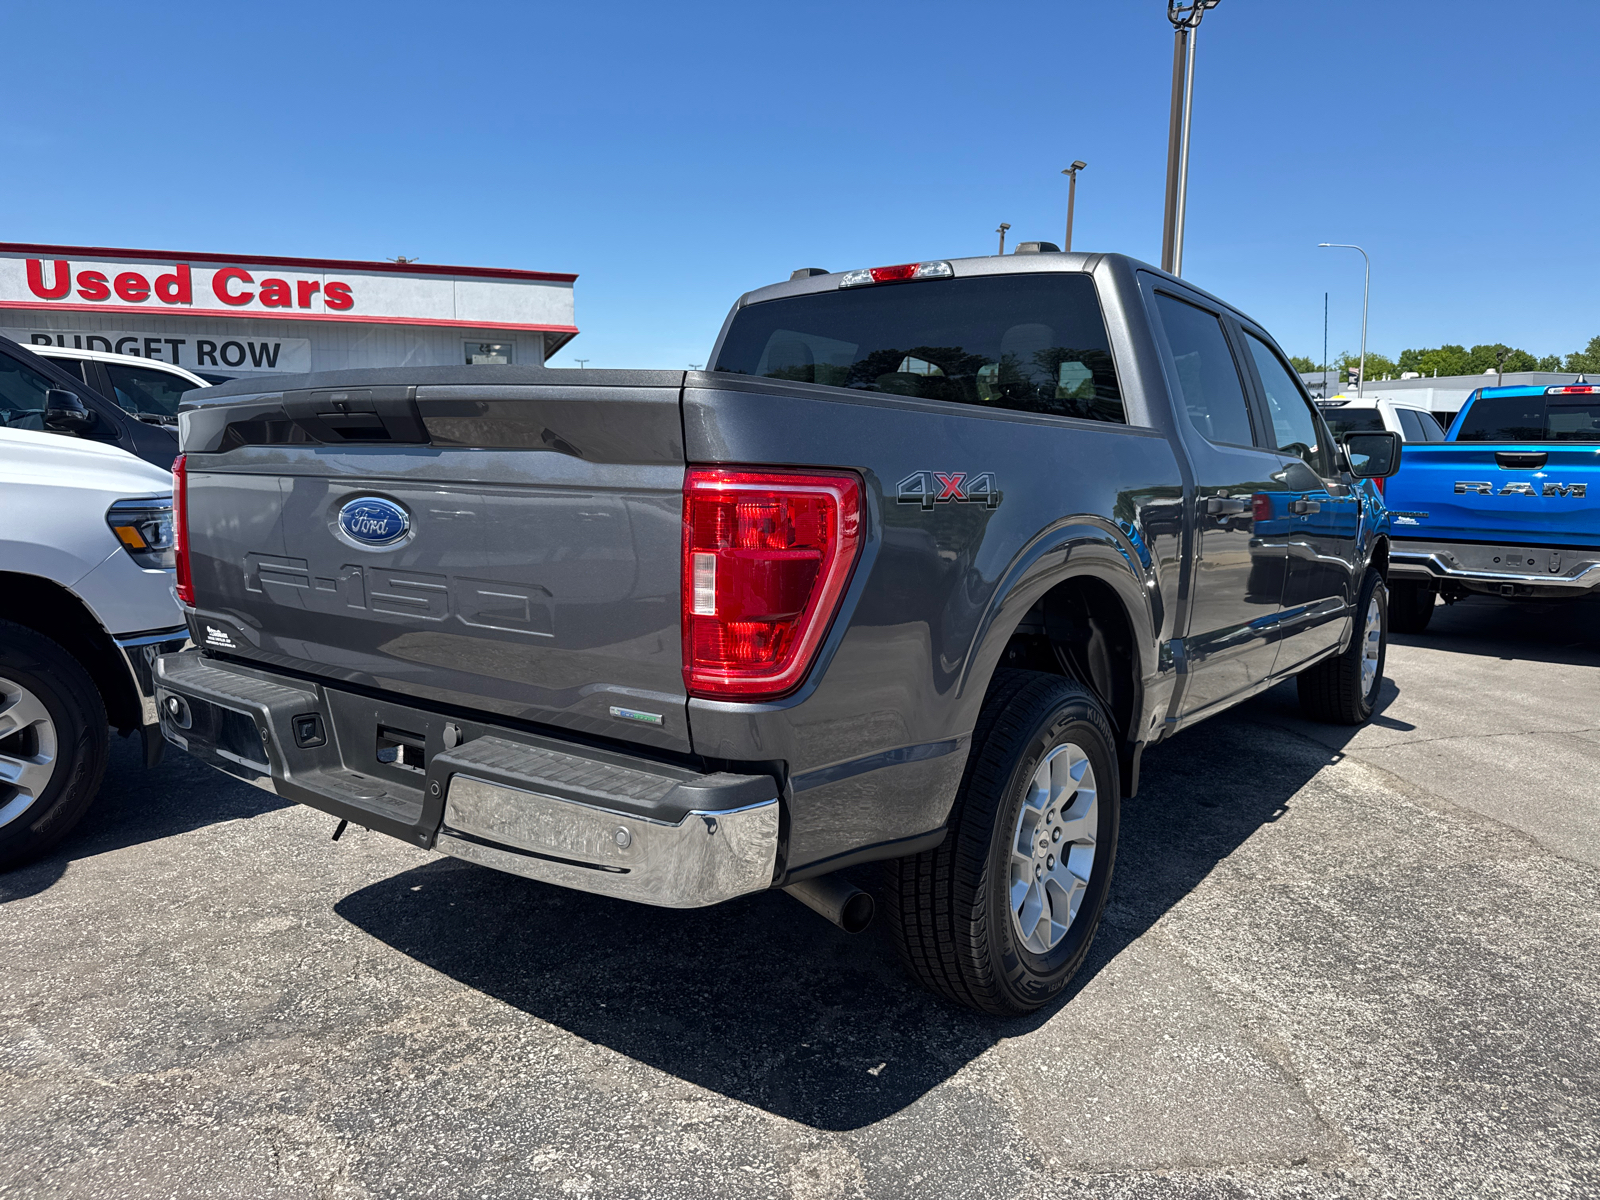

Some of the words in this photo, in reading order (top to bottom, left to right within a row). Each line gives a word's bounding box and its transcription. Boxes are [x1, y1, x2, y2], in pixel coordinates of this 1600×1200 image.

[26, 258, 193, 305] Used
[211, 266, 355, 312] Cars
[196, 340, 282, 368] ROW
[1454, 480, 1588, 498] RAM
[351, 507, 389, 535] Ford
[242, 551, 555, 637] F-150
[1086, 706, 1116, 753] KUMHO
